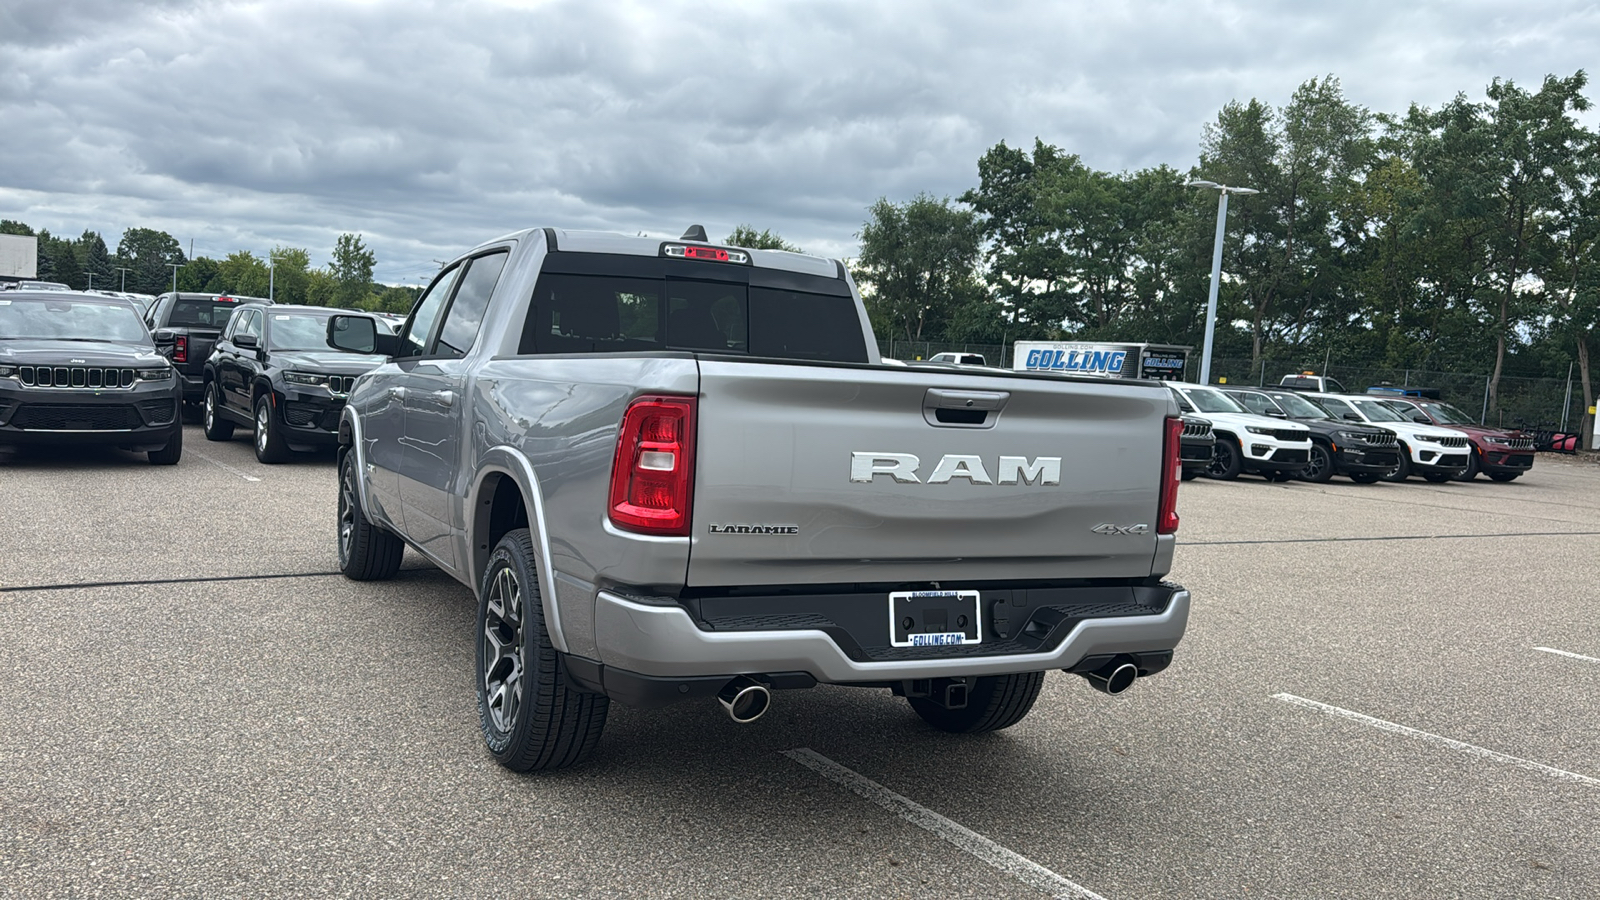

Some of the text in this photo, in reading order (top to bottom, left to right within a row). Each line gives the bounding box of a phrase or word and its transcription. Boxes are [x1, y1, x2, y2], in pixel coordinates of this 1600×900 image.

[1025, 349, 1127, 373] GOLLING
[1143, 357, 1184, 369] GOLLING
[850, 451, 1062, 486] RAM
[709, 523, 799, 535] LARAMIE
[913, 634, 962, 646] GOLLING.COM
